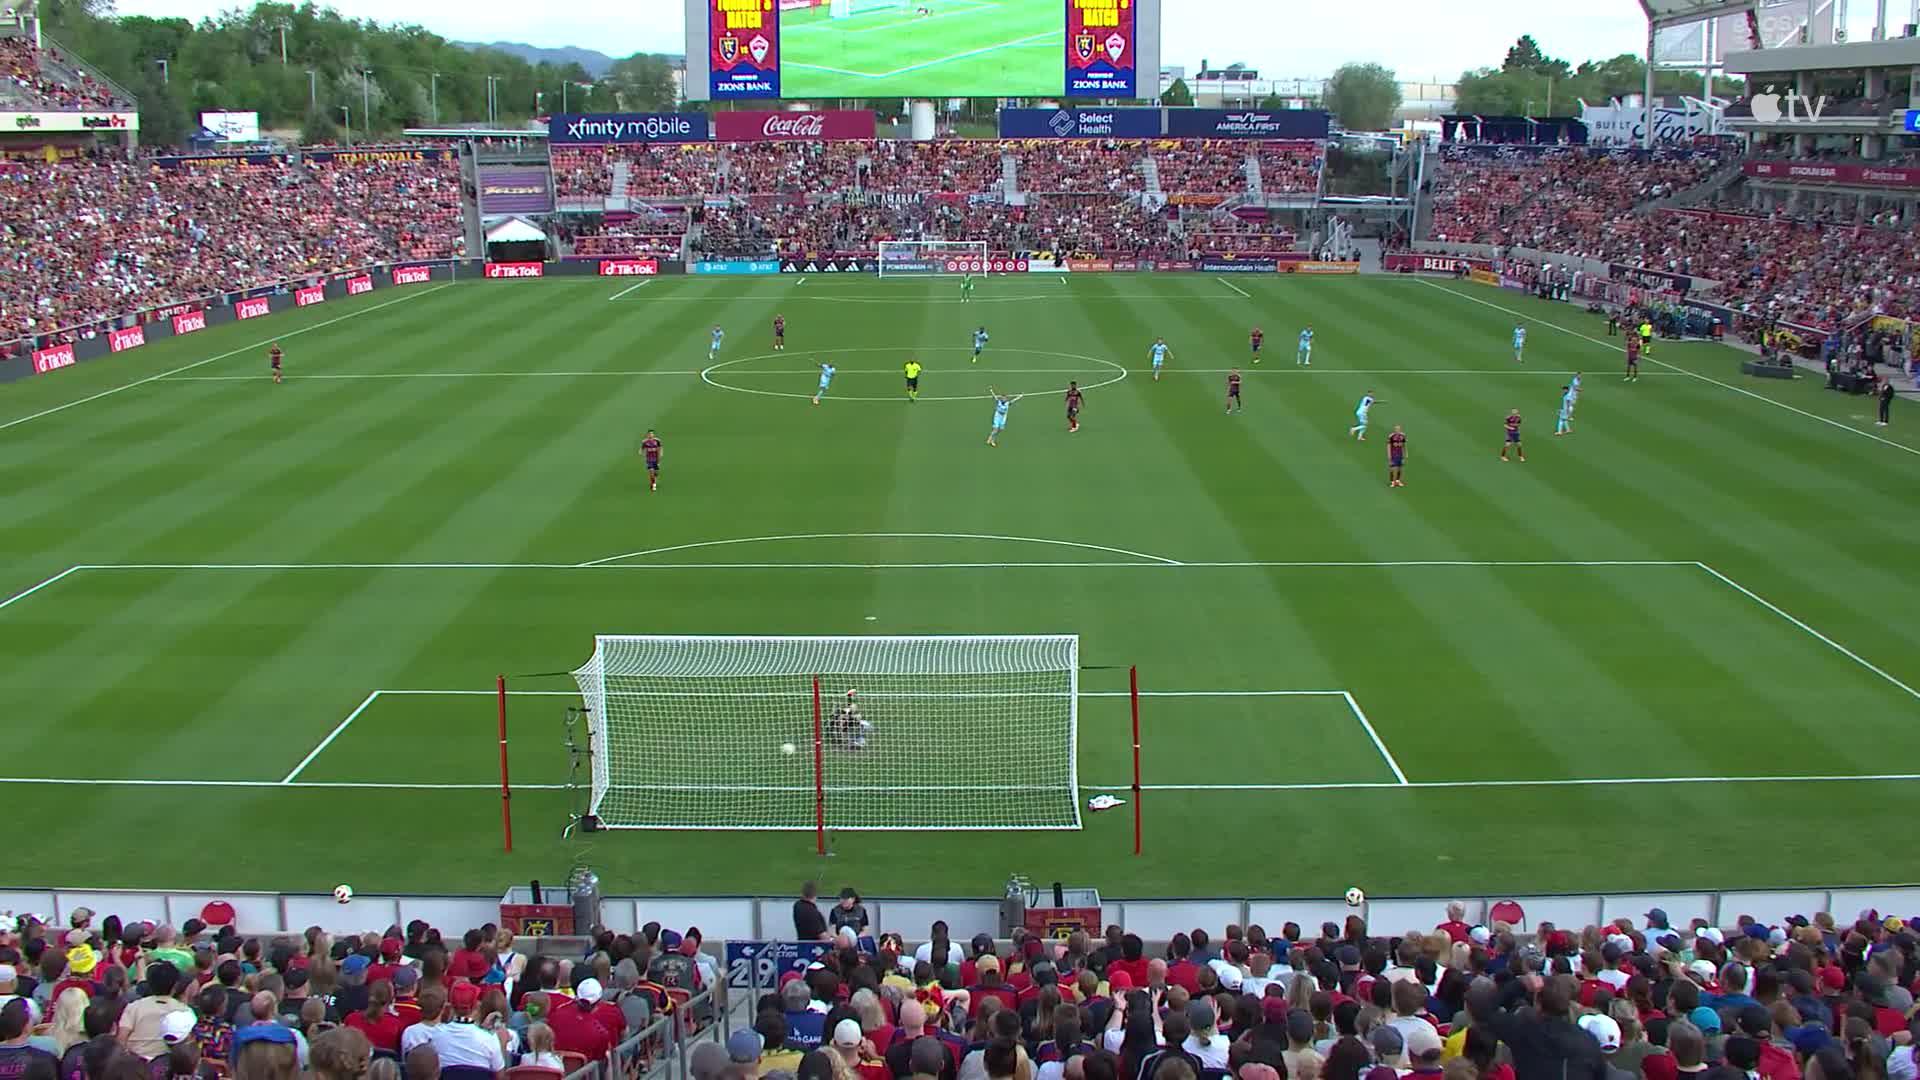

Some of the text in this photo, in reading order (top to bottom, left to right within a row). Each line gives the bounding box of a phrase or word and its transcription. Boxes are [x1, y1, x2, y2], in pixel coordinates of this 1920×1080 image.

[726, 11, 762, 28] MATCH
[1083, 9, 1119, 26] MATCH
[717, 82, 772, 91] ZIONS BANK
[1072, 80, 1101, 89] ZIONS
[1079, 113, 1113, 123] Select
[567, 118, 625, 139] xfinity
[1079, 124, 1111, 134] Health
[1216, 122, 1280, 131] AMERICA FIRST
[503, 265, 539, 277] TikTok
[617, 263, 654, 275] TikTok
[401, 270, 428, 283] TikTok
[47, 351, 75, 370] TikTok
[731, 958, 777, 987] 29
